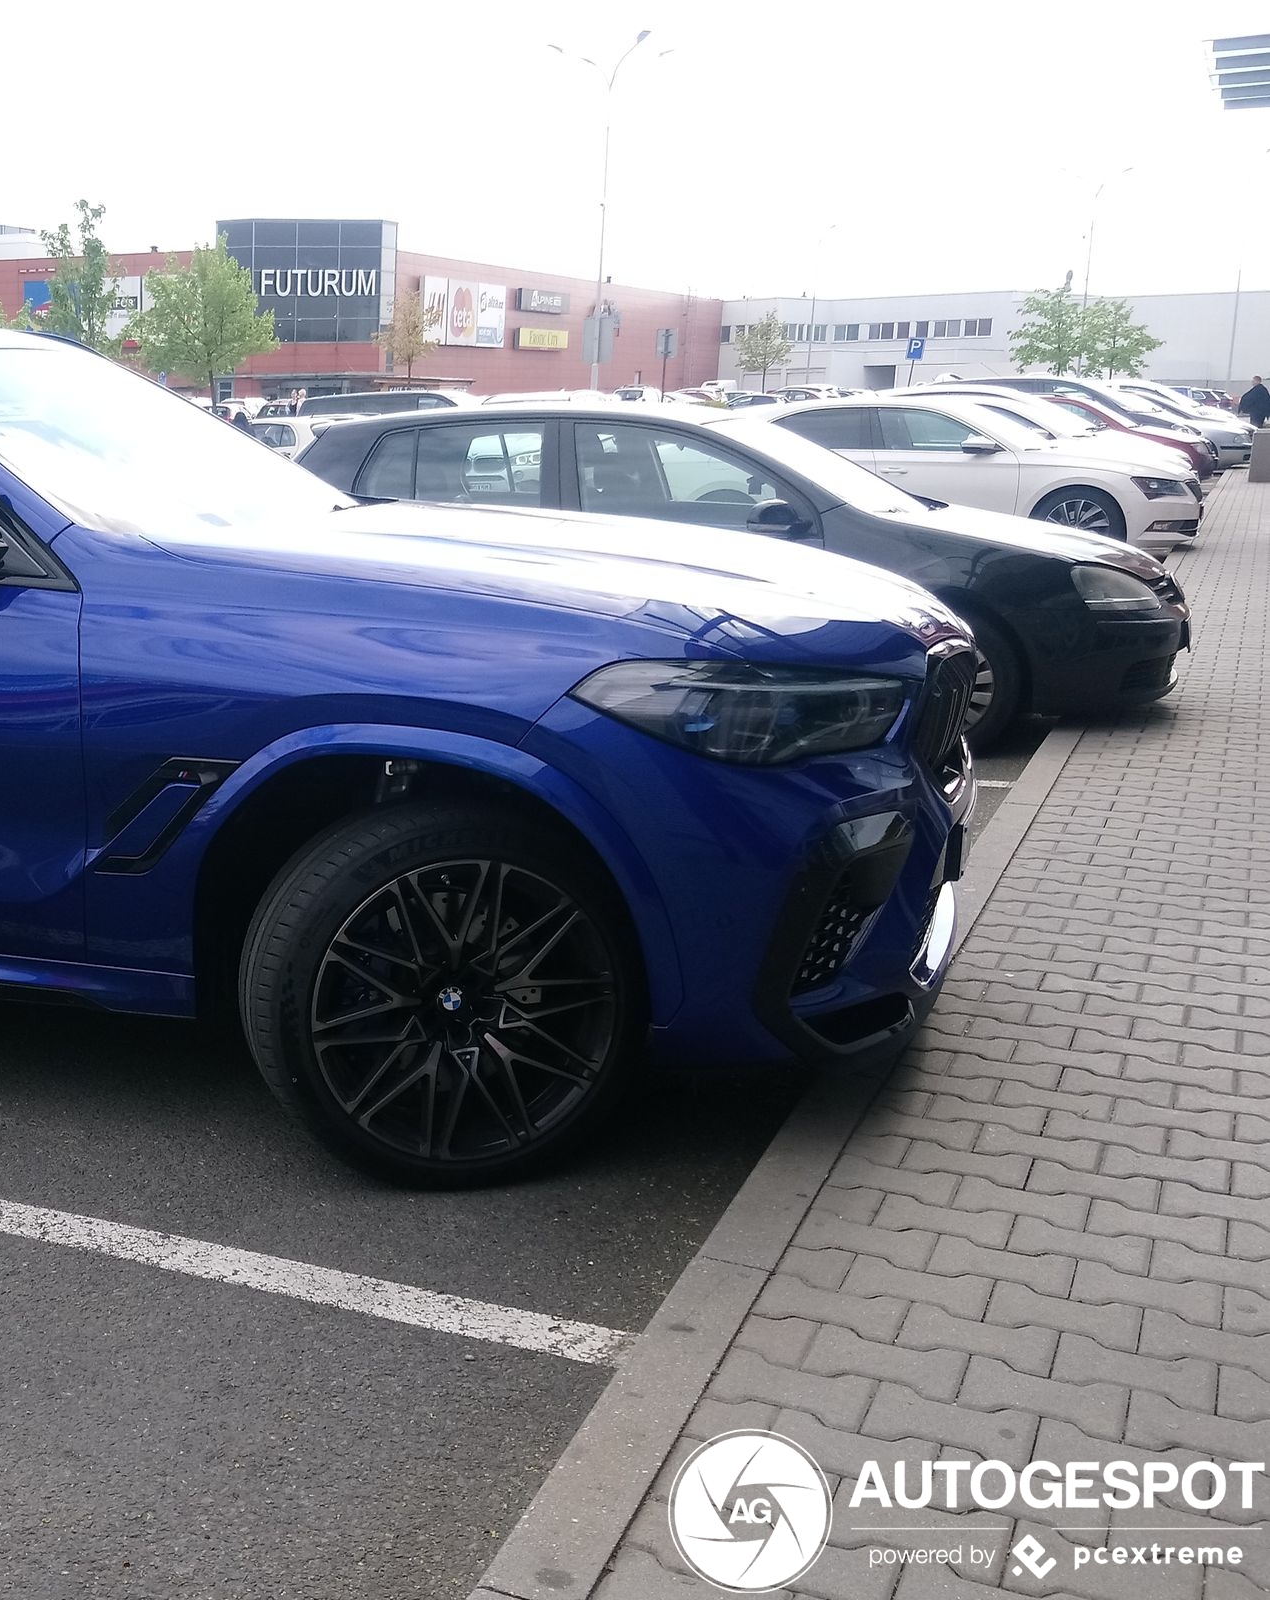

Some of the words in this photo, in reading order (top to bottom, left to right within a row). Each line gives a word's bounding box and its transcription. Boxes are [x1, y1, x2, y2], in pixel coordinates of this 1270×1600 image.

[260, 269, 376, 297] FUTURUM
[453, 307, 474, 328] teta
[910, 340, 921, 353] P
